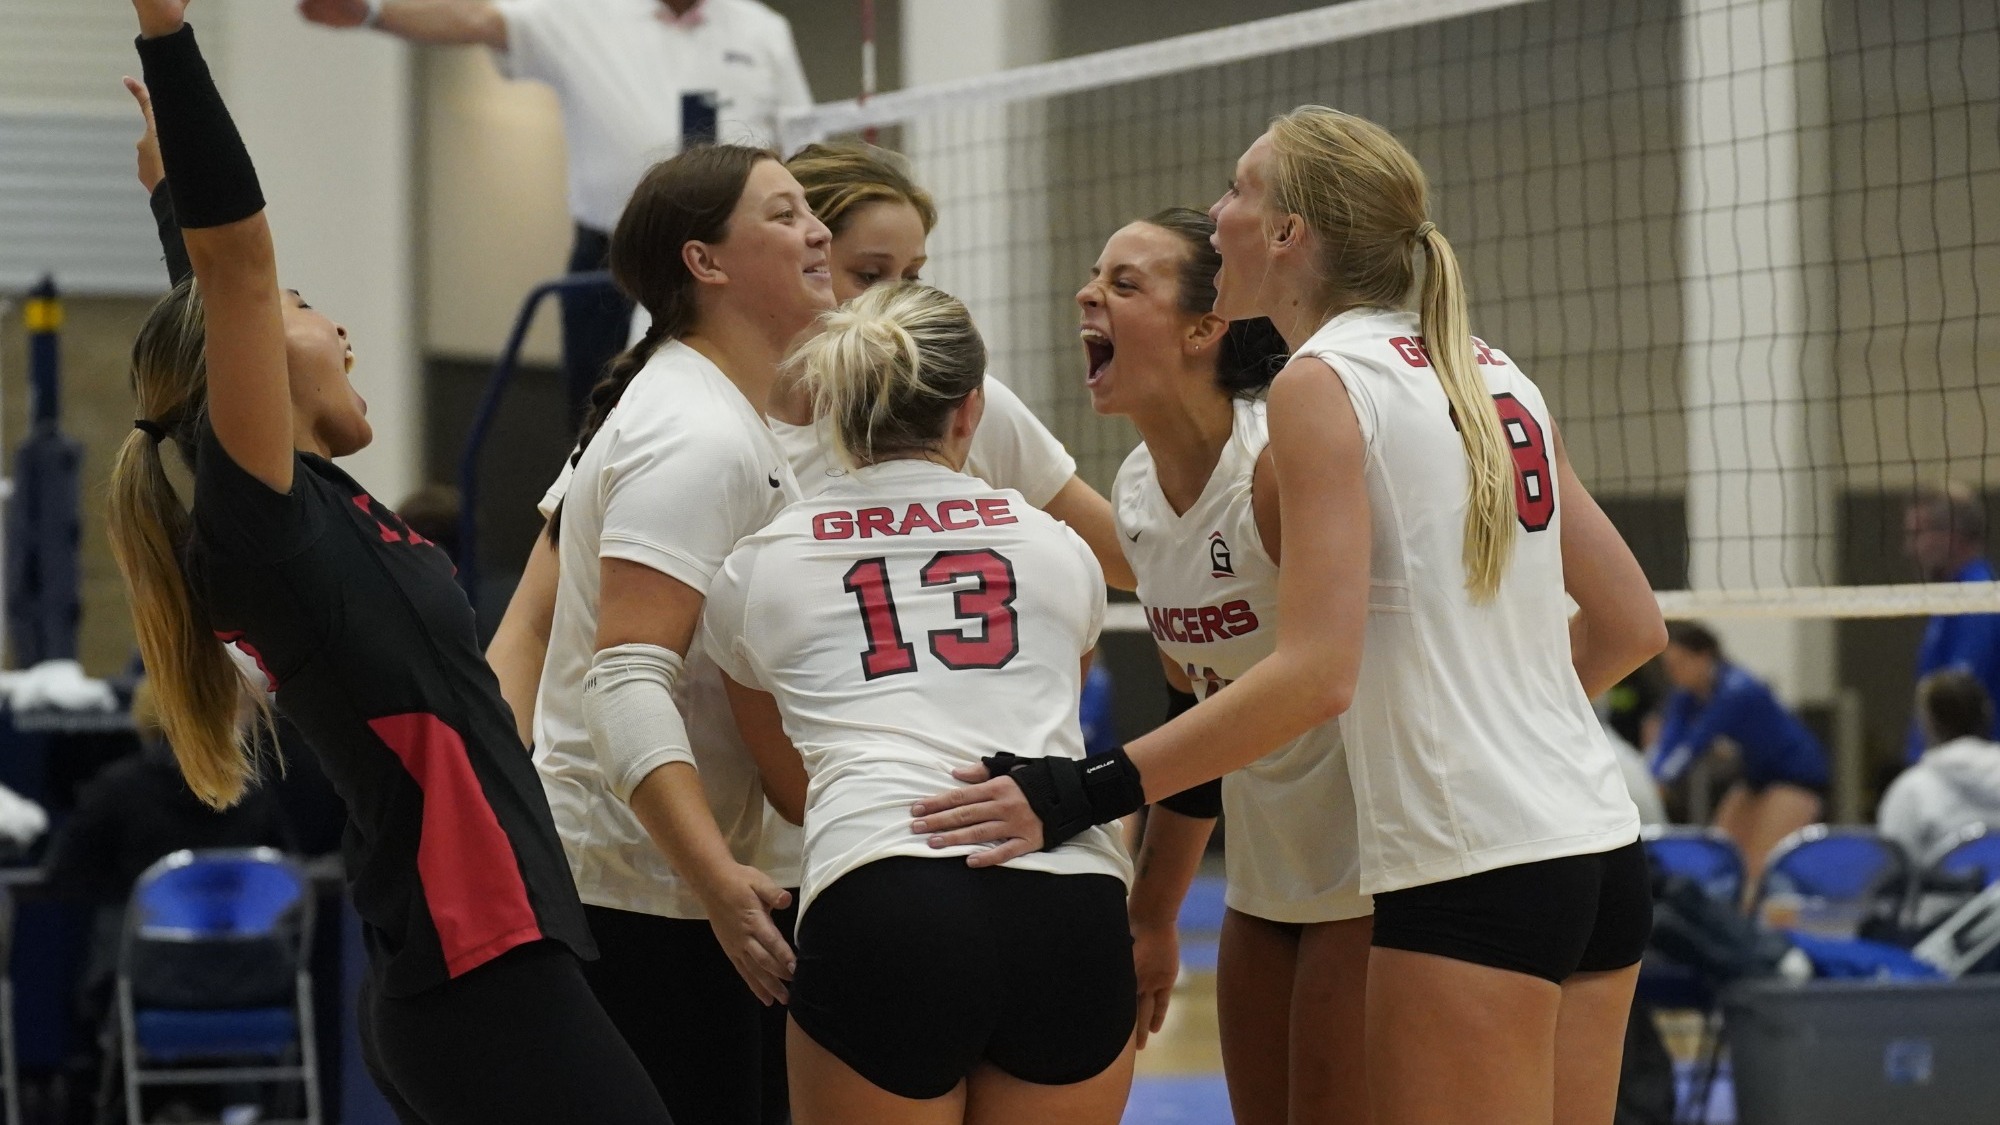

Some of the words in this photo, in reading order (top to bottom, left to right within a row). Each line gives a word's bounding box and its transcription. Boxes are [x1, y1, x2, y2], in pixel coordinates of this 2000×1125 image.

[1388, 335, 1507, 367] GRE
[1448, 392, 1555, 533] 8
[811, 498, 1019, 541] GRACE
[842, 547, 1020, 682] 13
[1143, 599, 1259, 643] ANCERS
